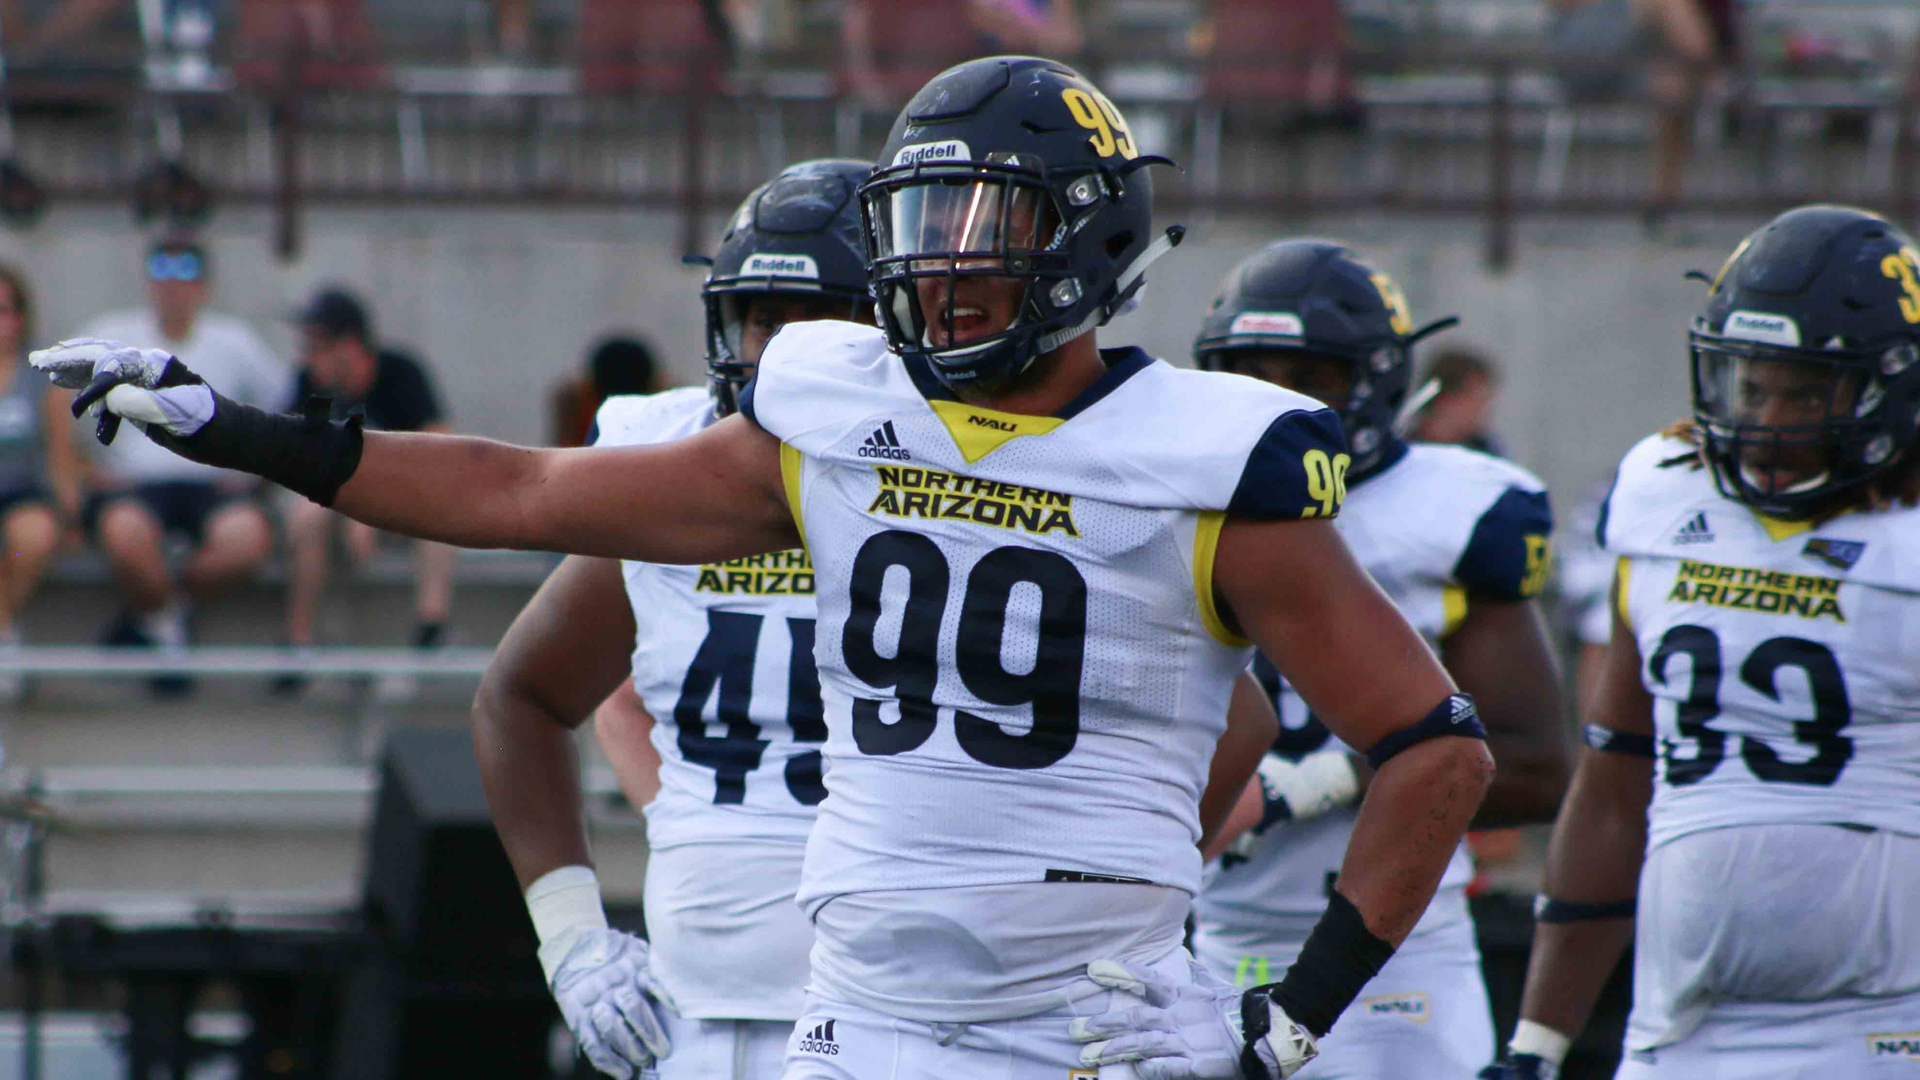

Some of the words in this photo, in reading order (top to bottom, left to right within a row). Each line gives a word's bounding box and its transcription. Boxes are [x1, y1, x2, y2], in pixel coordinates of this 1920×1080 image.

[1061, 88, 1138, 161] 99
[901, 144, 956, 165] Riddell
[751, 259, 806, 271] Riddell
[968, 415, 1018, 432] NAU
[858, 445, 911, 460] adidas
[876, 467, 1074, 507] NORTHERN
[868, 489, 1080, 537] ARIZONA
[1680, 561, 1842, 595] NORTHERN
[1668, 579, 1847, 623] ARIZONA
[842, 529, 1088, 769] 99
[1650, 624, 1853, 788] 33
[799, 1038, 840, 1056] adidas
